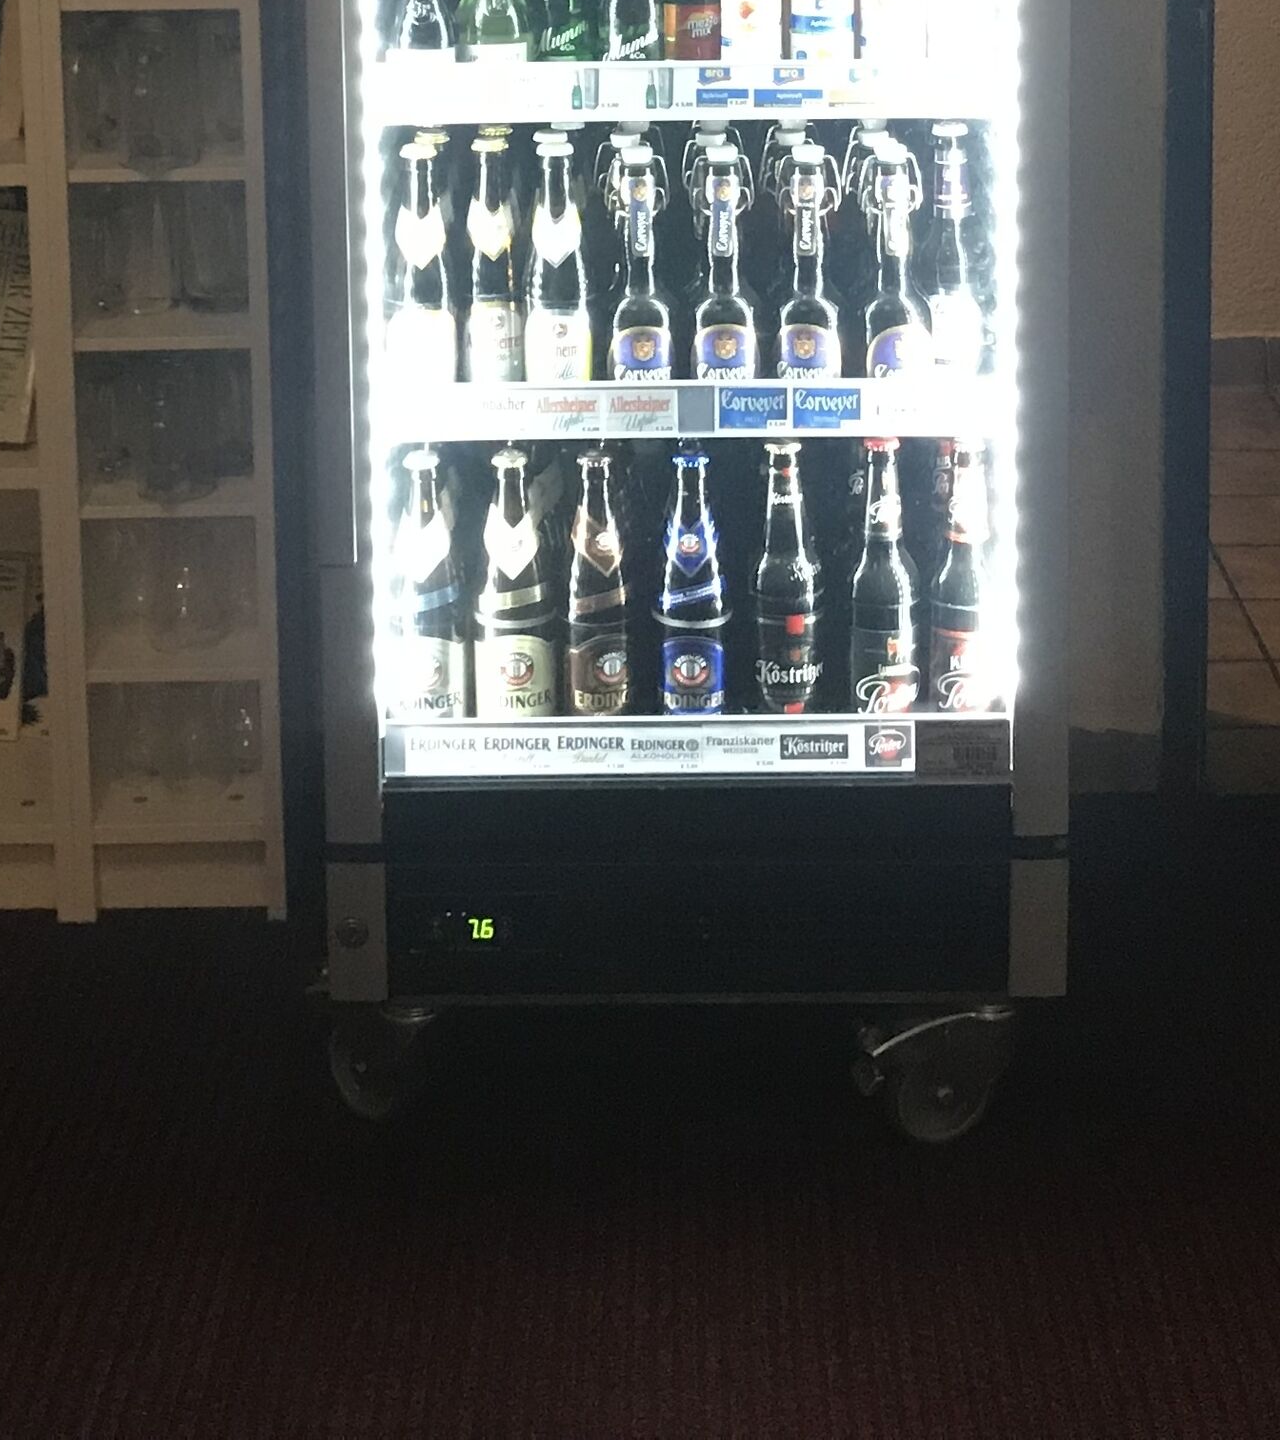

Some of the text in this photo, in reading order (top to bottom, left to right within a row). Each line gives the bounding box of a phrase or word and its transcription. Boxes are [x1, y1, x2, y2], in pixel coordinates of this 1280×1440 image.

[691, 27, 712, 39] mix
[799, 208, 816, 251] Corveyer
[536, 395, 598, 414] Allersheimer
[609, 395, 672, 414] Allersheimer
[721, 388, 786, 417] Corveyer
[794, 388, 860, 418] Corveyer
[756, 658, 824, 686] Köstritzer
[399, 690, 464, 710] RDINGER
[498, 689, 553, 710] DINGER
[410, 736, 478, 752] ERDINGER
[483, 735, 552, 752] ERDINGER
[556, 734, 625, 752] ERDINGER
[630, 737, 686, 752] ERDINGER
[705, 735, 775, 747] Franziskaner
[782, 736, 846, 758] Köstritzer
